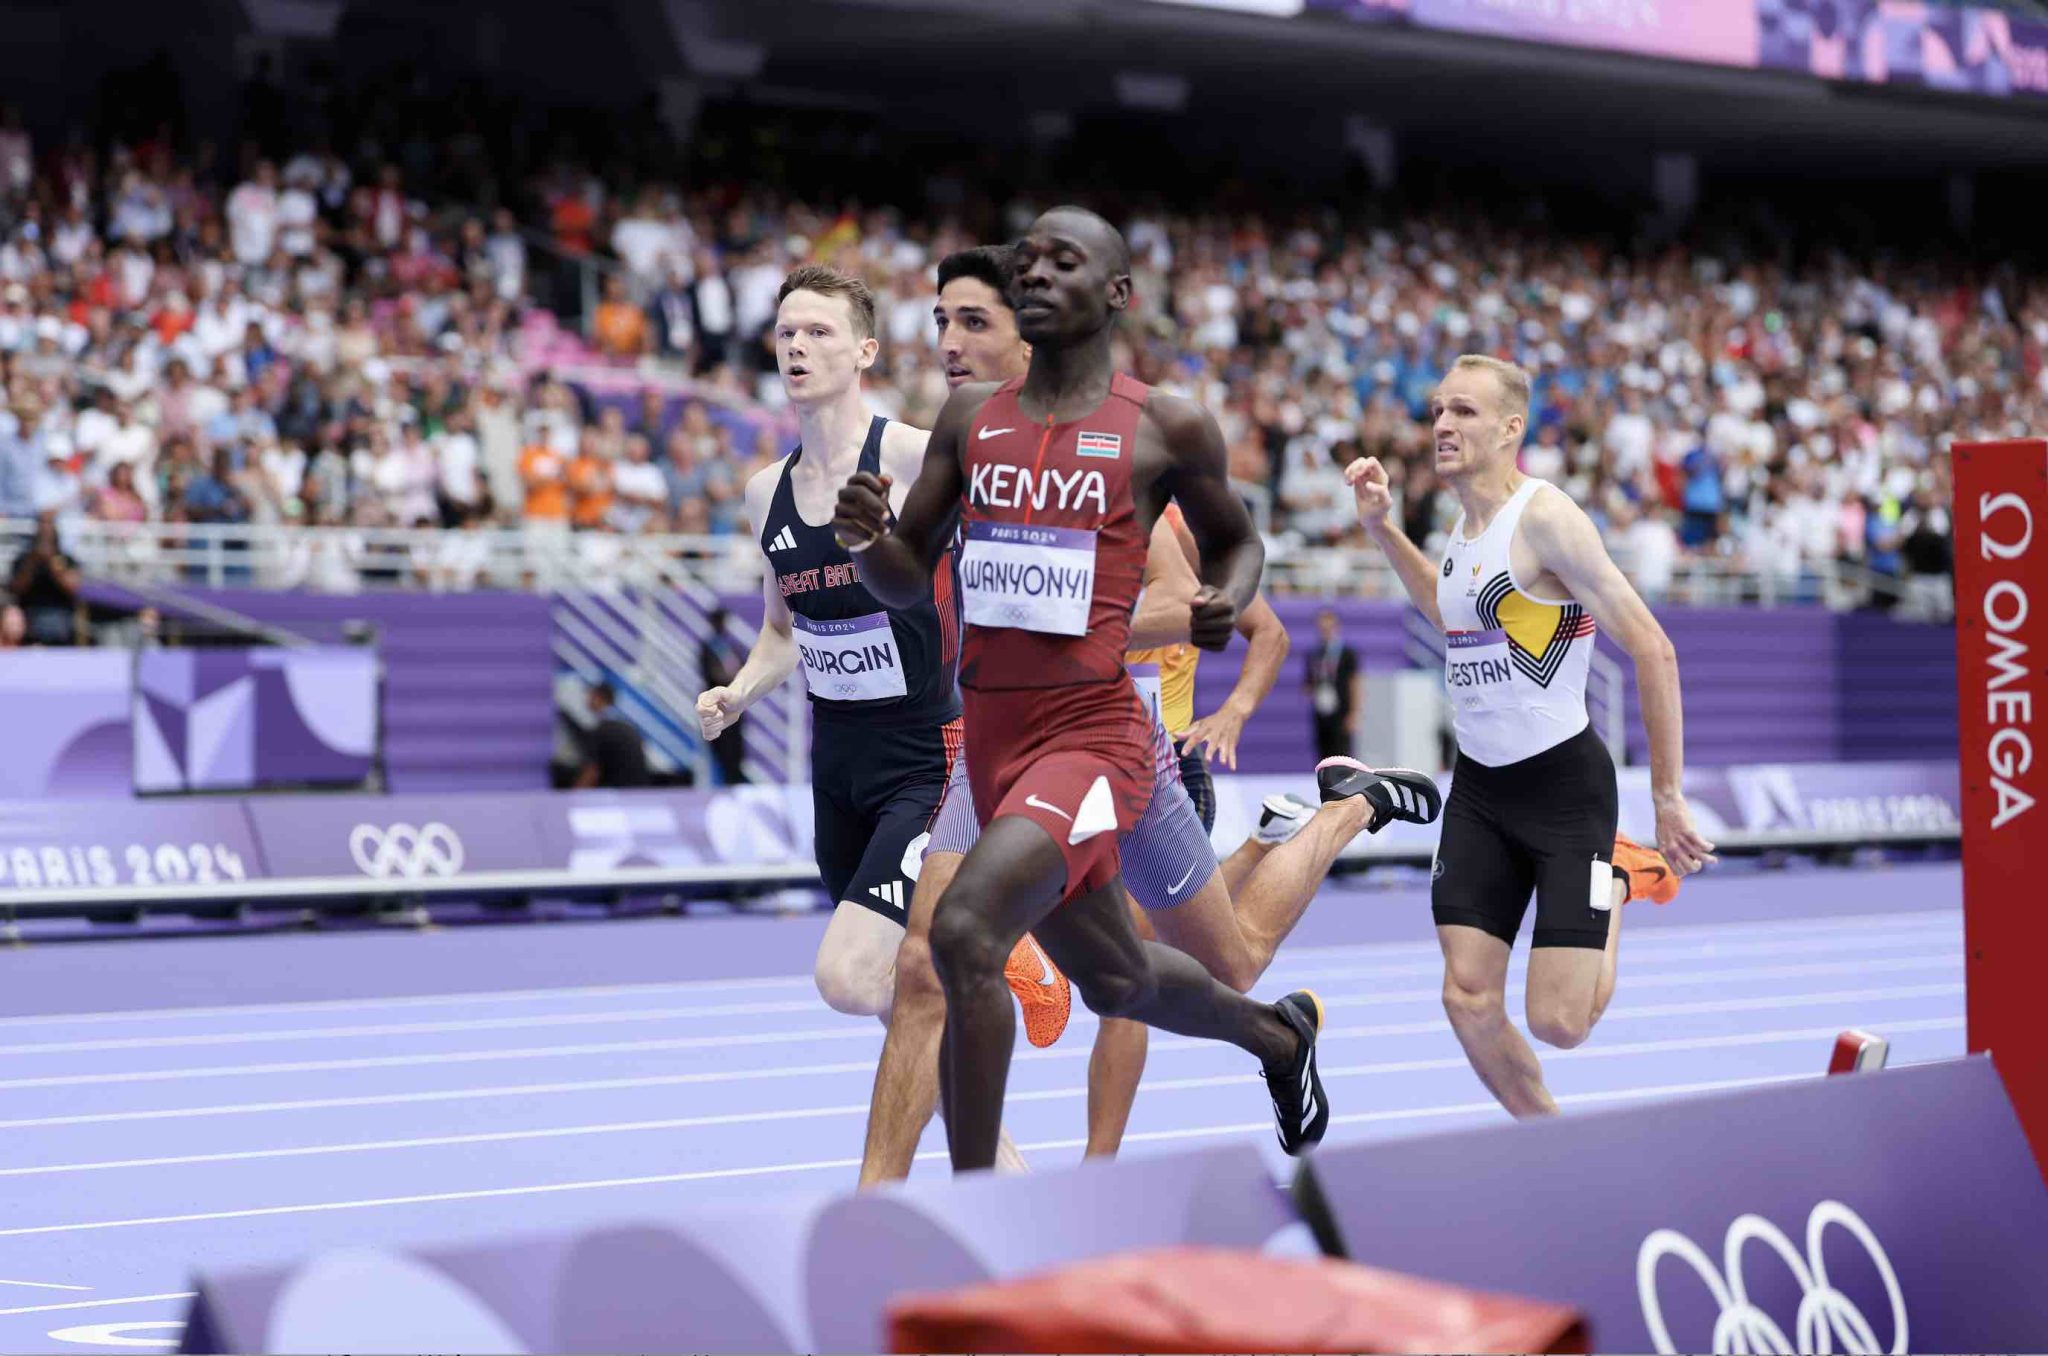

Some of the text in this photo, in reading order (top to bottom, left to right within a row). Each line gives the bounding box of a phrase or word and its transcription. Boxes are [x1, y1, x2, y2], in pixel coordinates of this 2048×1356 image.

[969, 462, 1106, 514] KENYA
[991, 527, 1057, 543] PARIS 2024
[778, 568, 820, 597] GREAT
[964, 559, 1088, 600] WANYONYI
[829, 623, 856, 632] 2024
[799, 642, 894, 675] BURGIN
[1983, 580, 2036, 830] OMEGA
[126, 843, 244, 885] 2024
